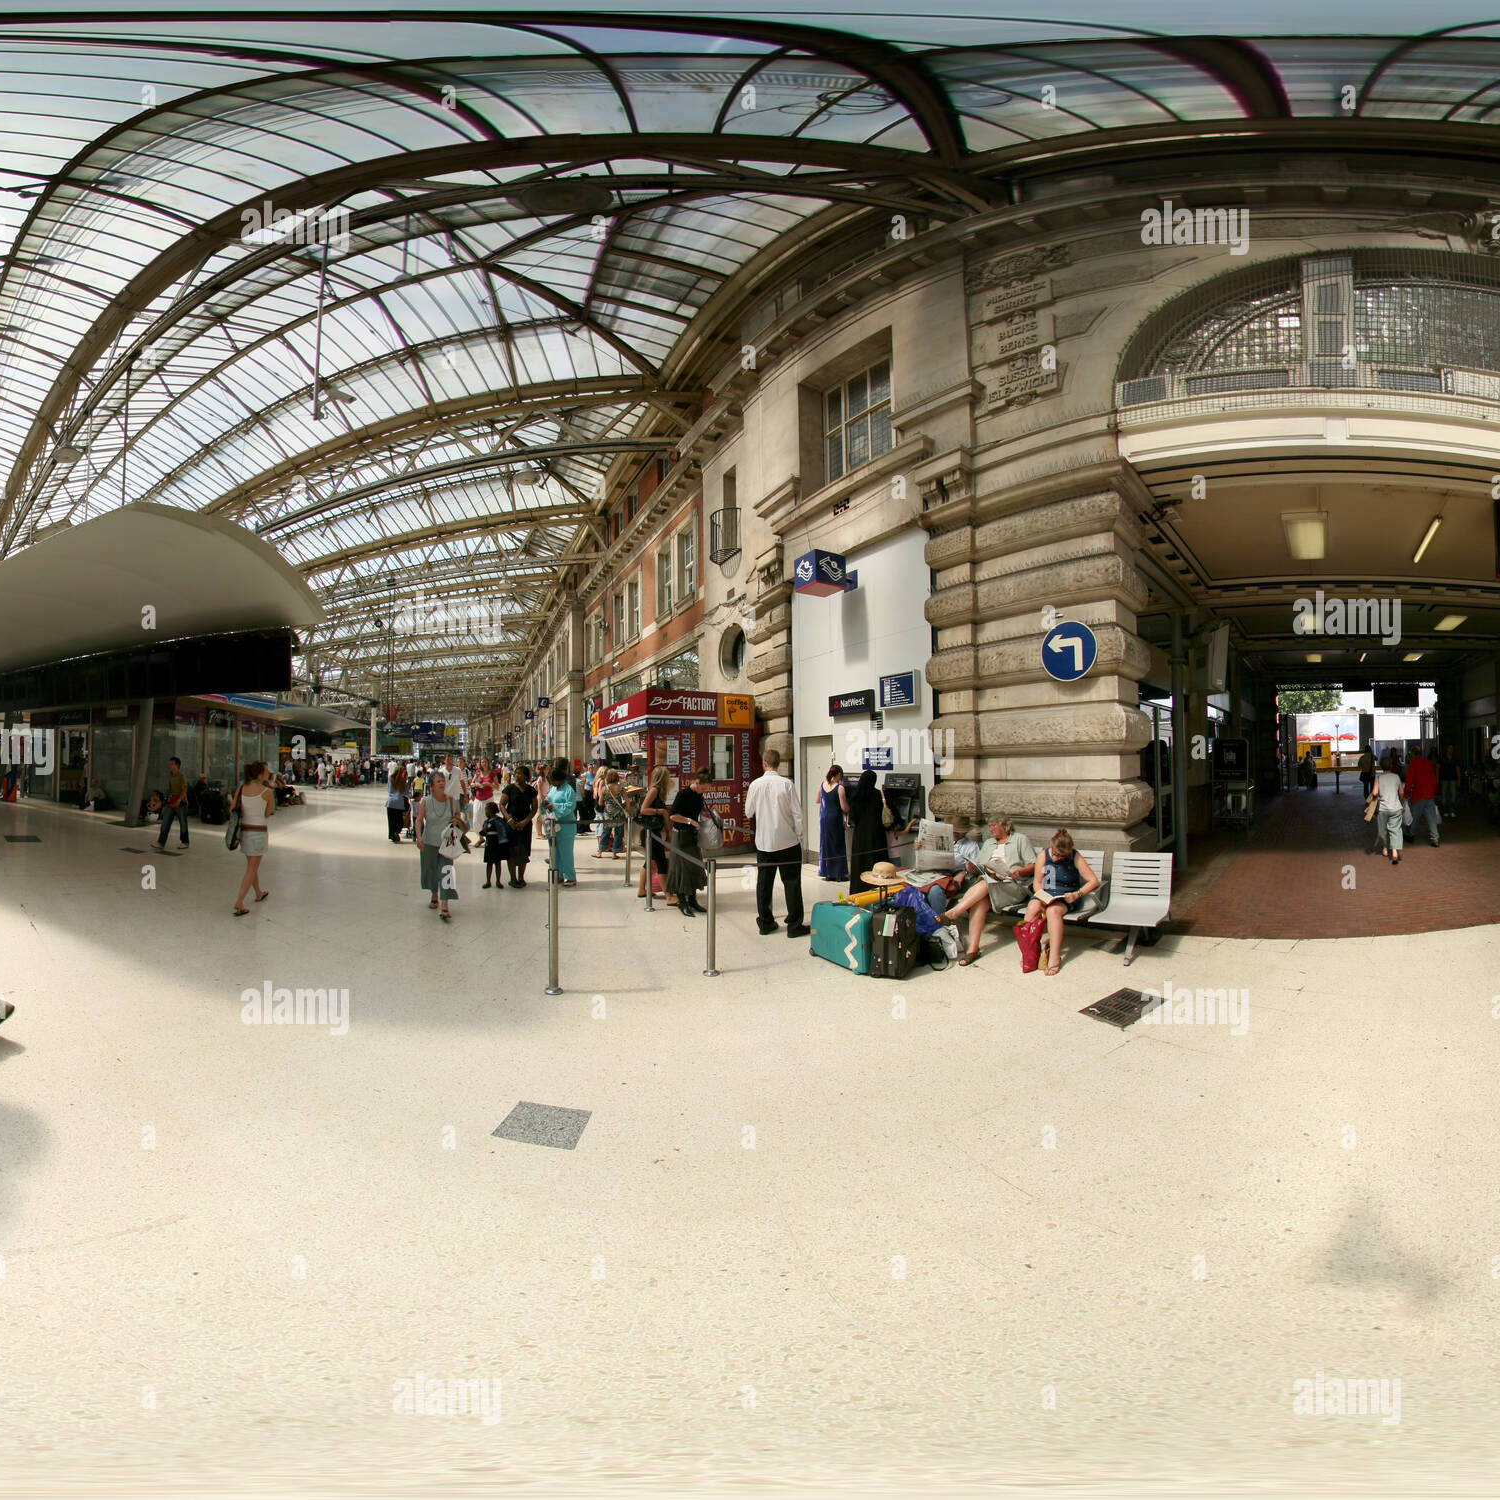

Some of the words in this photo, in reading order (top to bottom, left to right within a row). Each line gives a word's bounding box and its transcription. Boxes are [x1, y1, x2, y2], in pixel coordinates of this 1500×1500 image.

[994, 294, 1038, 315] SURREY
[998, 321, 1037, 342] BUCKS
[1000, 335, 1037, 354] BERKS
[999, 365, 1041, 387] SUSSEX
[1019, 373, 1057, 393] WIGHT
[649, 696, 684, 711] Bagel
[682, 697, 717, 712] FACTORY
[840, 696, 865, 708] NatWest
[681, 732, 691, 752] FOR
[681, 754, 691, 774] YOU
[741, 732, 750, 779] DELICIOUS
[703, 791, 731, 799] NATURAL
[723, 830, 736, 842] LY
